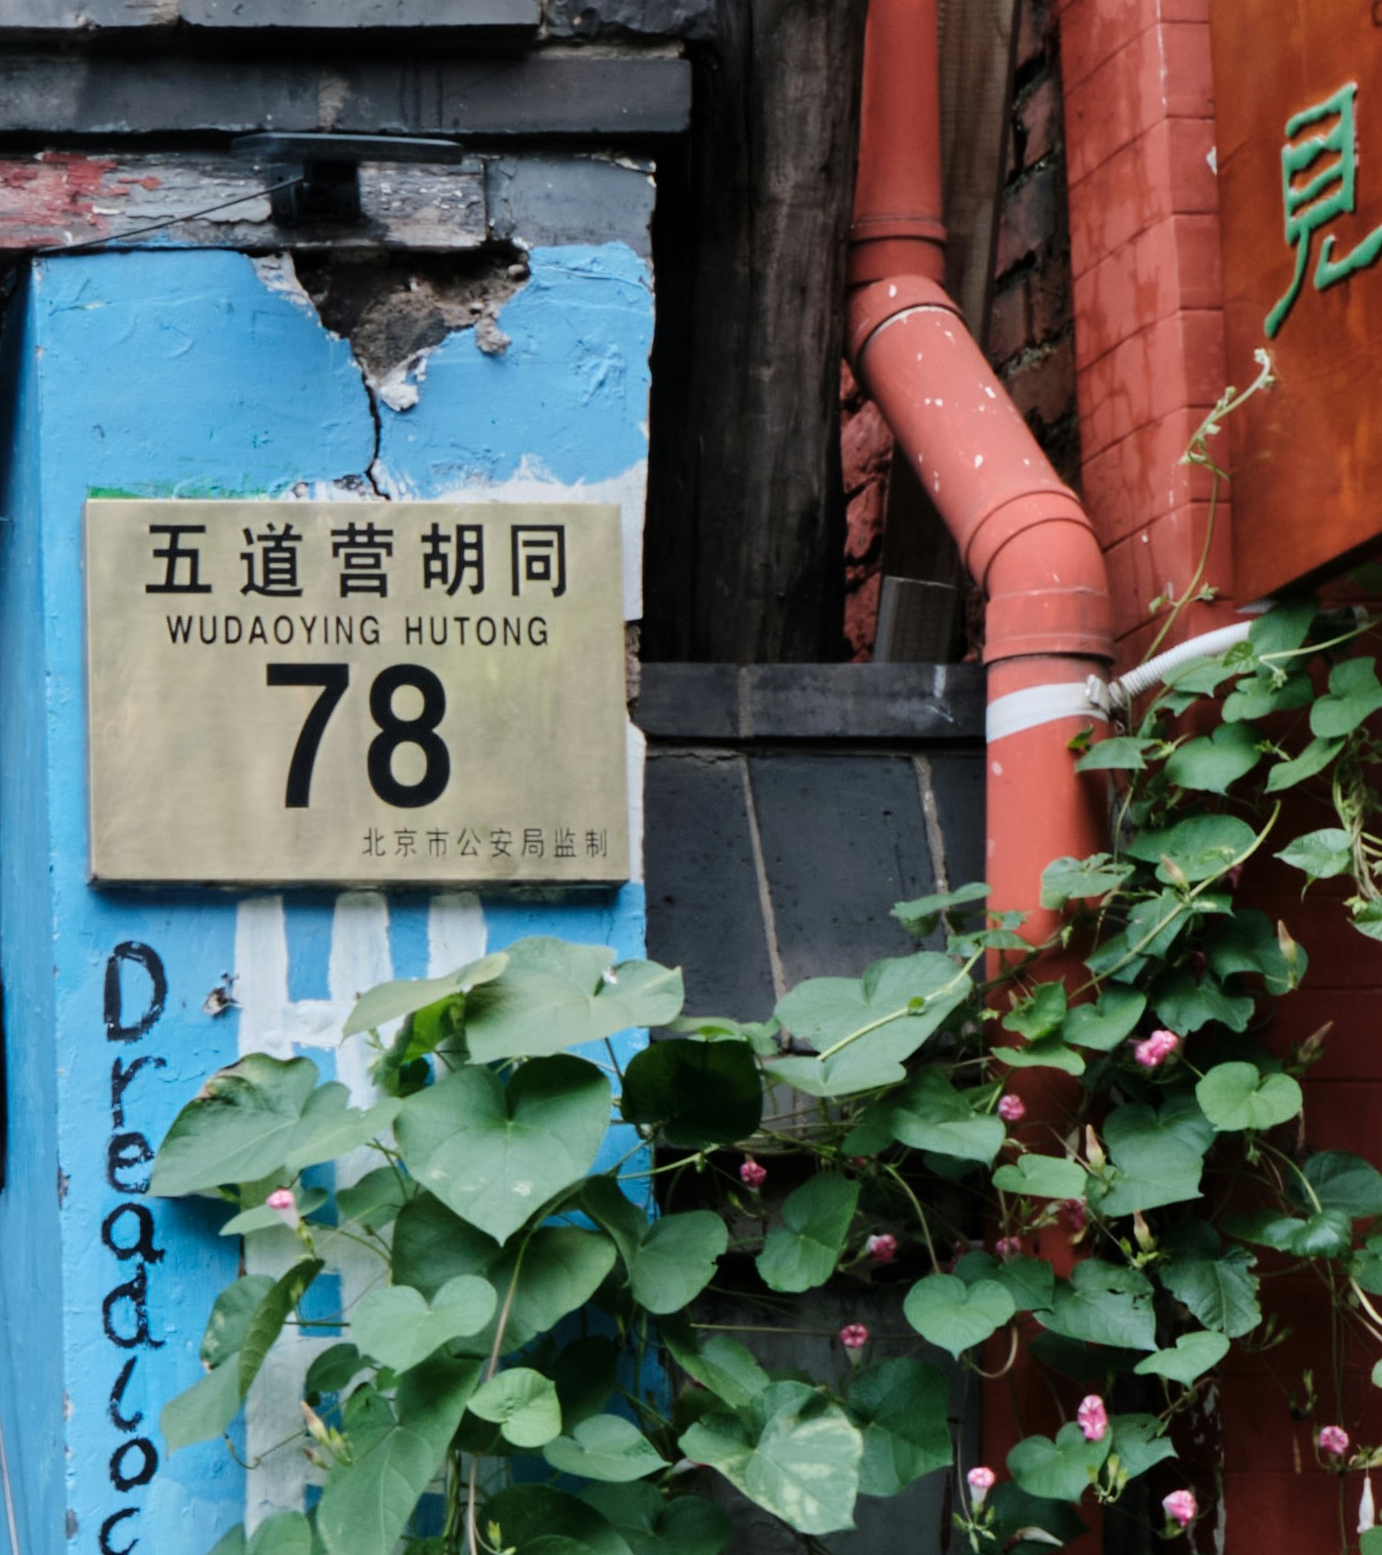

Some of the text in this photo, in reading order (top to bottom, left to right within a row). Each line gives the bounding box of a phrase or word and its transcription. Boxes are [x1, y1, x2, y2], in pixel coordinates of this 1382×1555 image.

[144, 521, 568, 599] 五道营胡同
[165, 614, 549, 646] WUDAOYING HUTONG
[266, 662, 452, 809] 78
[361, 827, 609, 859] 北京市公安局监制
